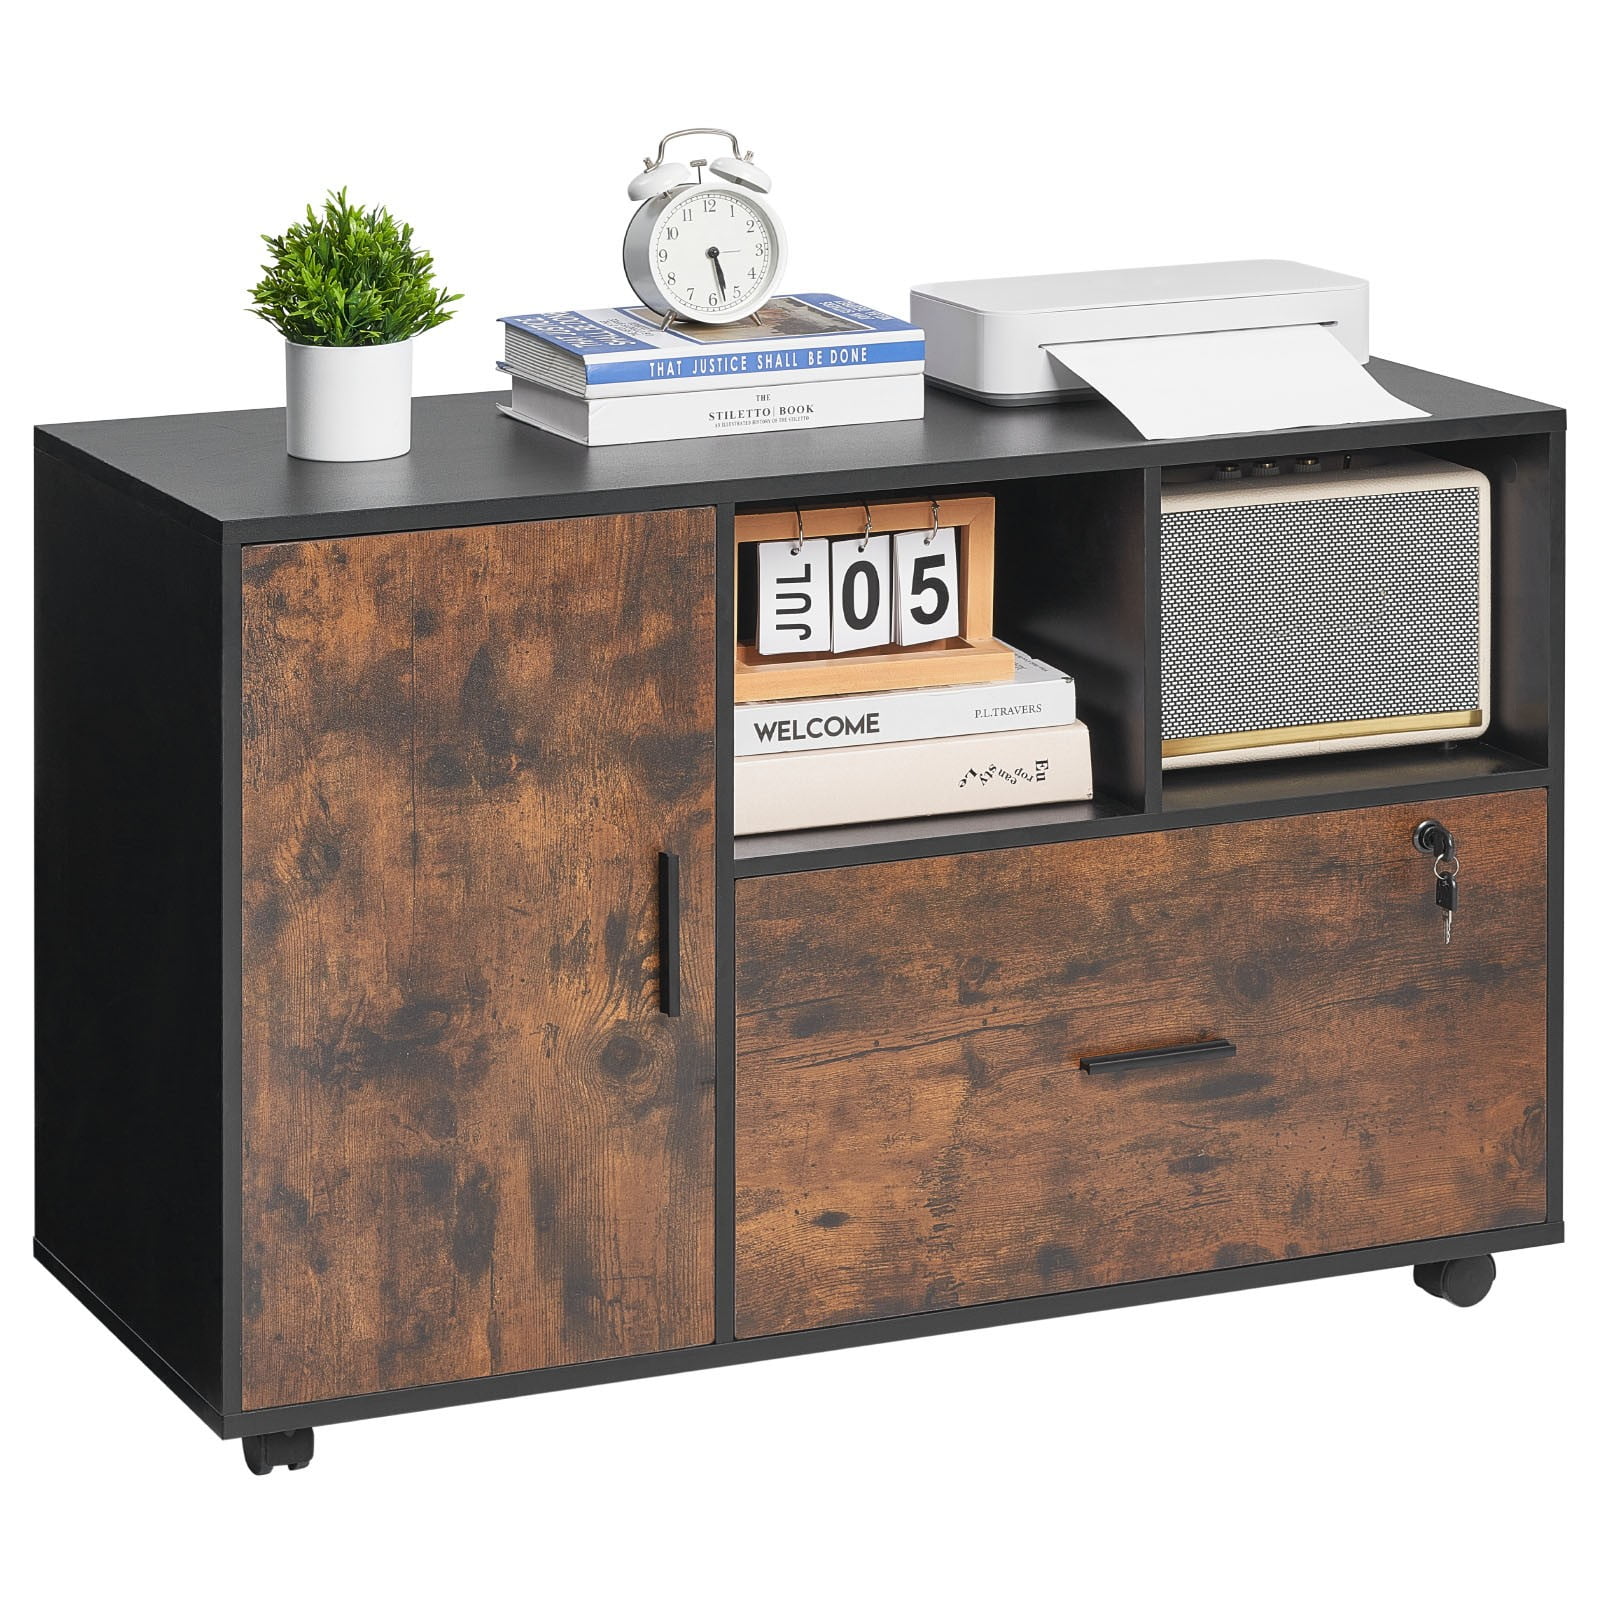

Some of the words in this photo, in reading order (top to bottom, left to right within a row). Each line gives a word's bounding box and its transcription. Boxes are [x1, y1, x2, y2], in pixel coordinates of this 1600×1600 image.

[703, 199, 717, 213] 12
[682, 209, 693, 222] 11
[746, 220, 755, 233] 2
[666, 227, 679, 240] 10
[658, 249, 668, 262] 9
[755, 243, 764, 256] 3
[667, 272, 676, 286] 8
[747, 267, 757, 280] 4
[686, 288, 695, 301] 7
[733, 286, 741, 299] 5
[708, 293, 718, 306] 6
[649, 360, 682, 377] THAT
[692, 356, 747, 374] JUSTICE
[757, 352, 798, 370] SHALL
[808, 350, 823, 366] BE
[830, 347, 867, 364] DONE
[756, 393, 771, 402] THE
[708, 407, 771, 421] STILETTO
[779, 404, 814, 416] BOOK
[775, 563, 812, 641] JUL
[753, 712, 881, 744] WELCOME
